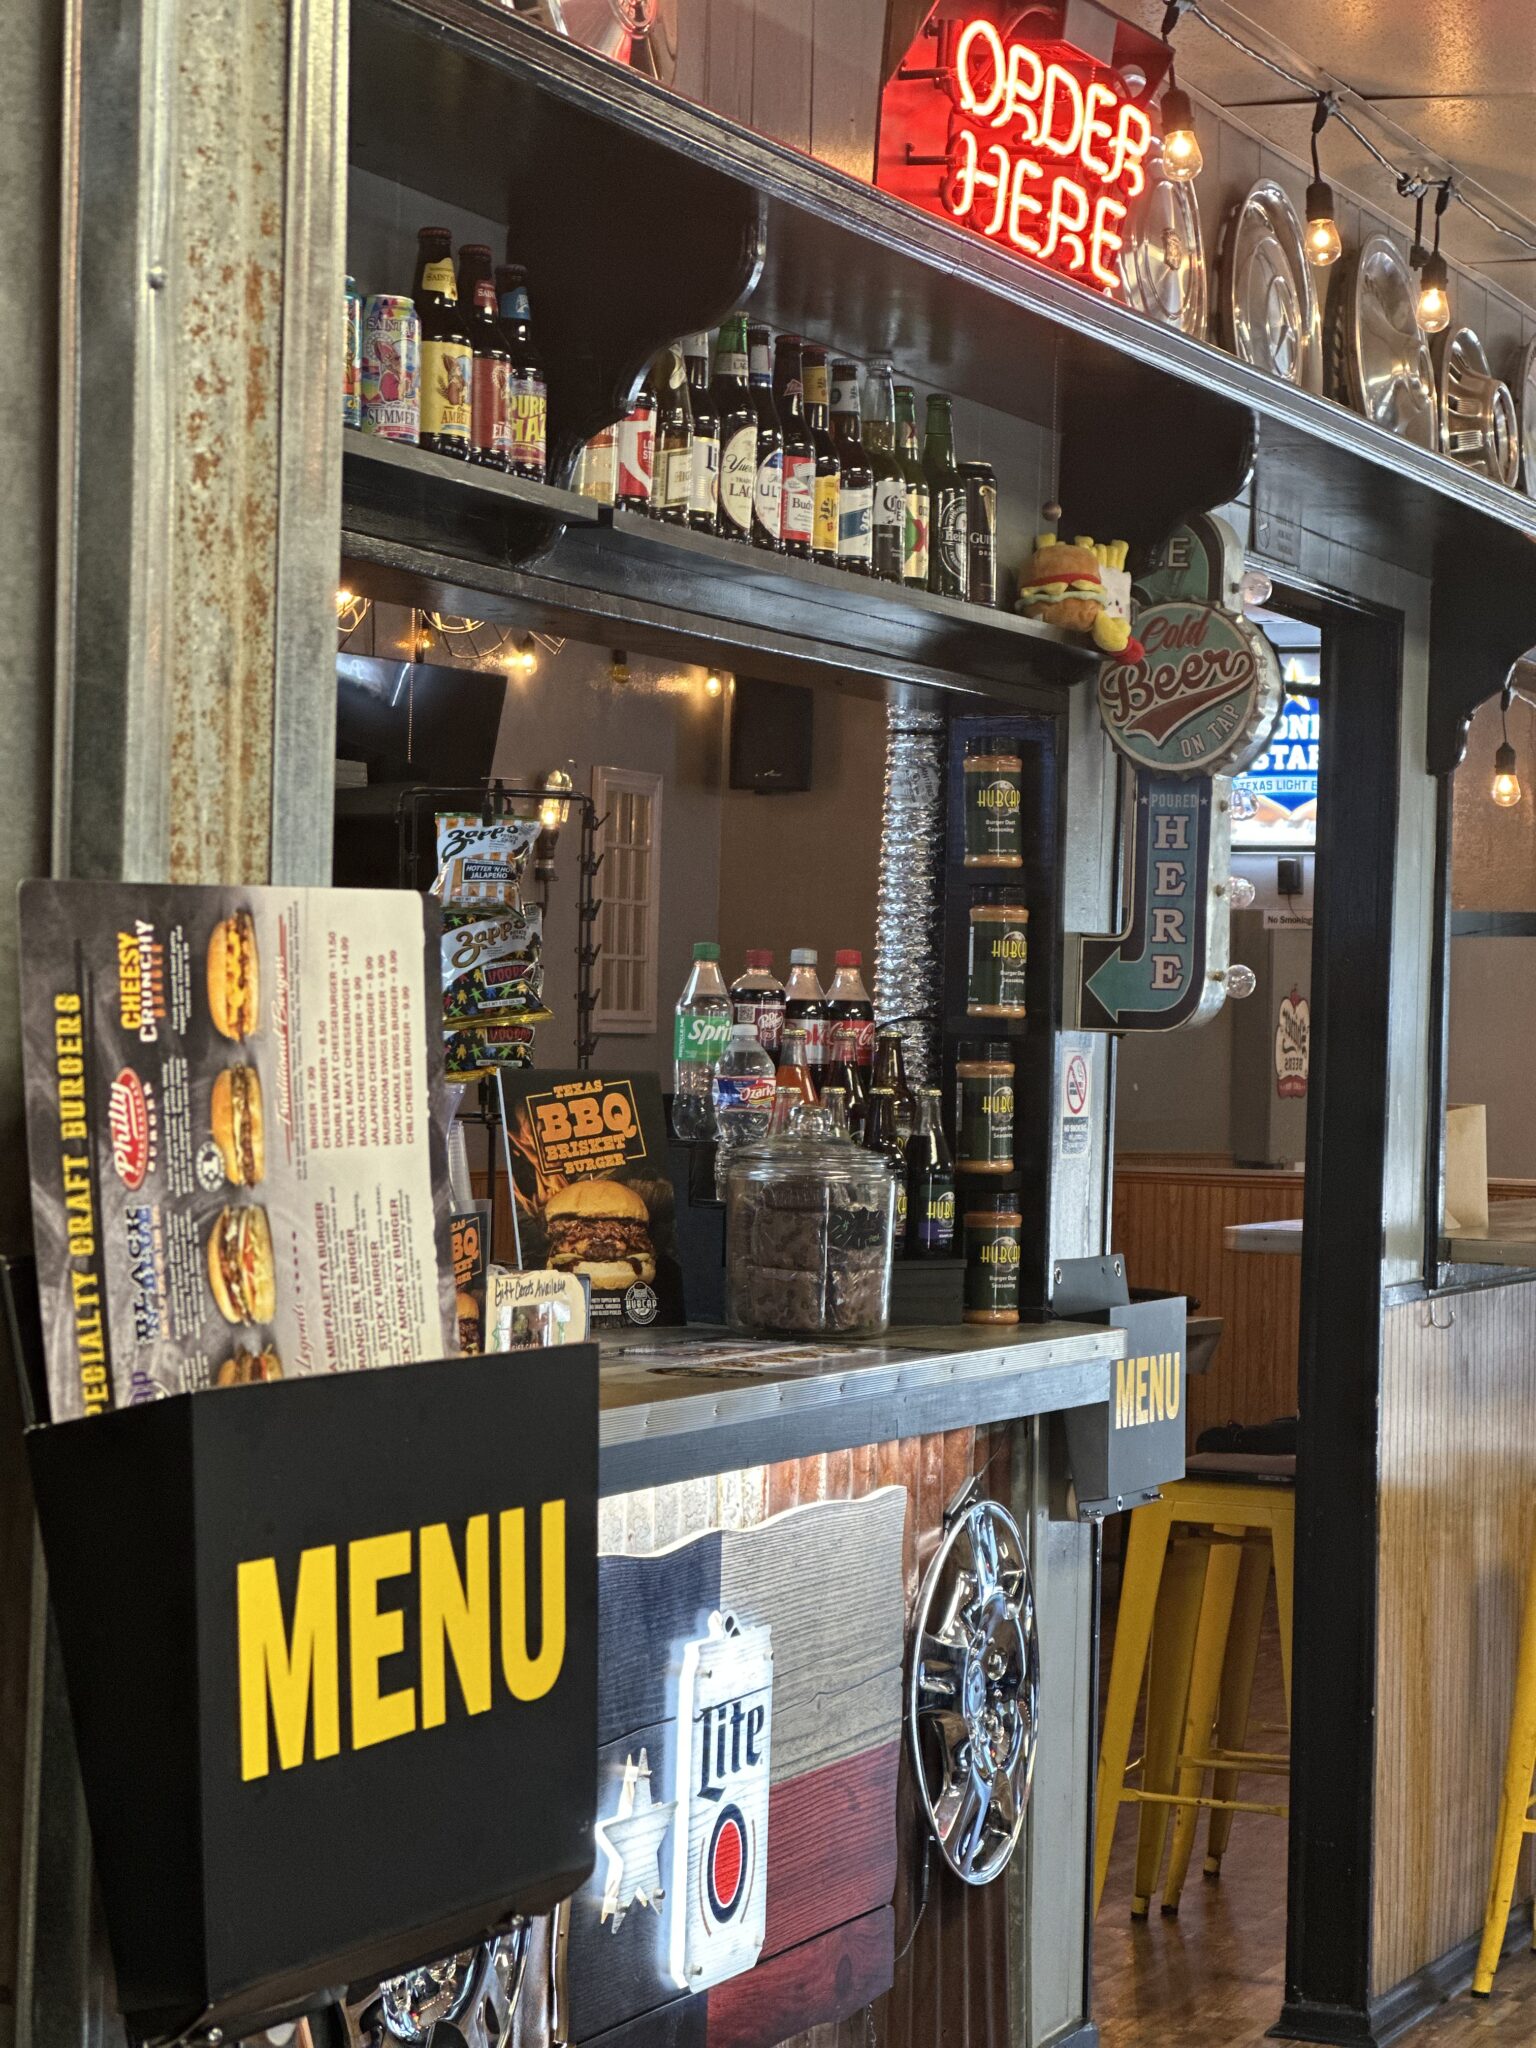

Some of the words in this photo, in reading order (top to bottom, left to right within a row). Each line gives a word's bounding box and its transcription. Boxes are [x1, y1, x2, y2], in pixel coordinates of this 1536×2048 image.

[957, 19, 1152, 197] ORDER
[953, 130, 1128, 288] HERE
[368, 408, 415, 426] SUMMER
[1140, 610, 1213, 655] Cold
[1099, 648, 1256, 728] Beer
[1178, 736, 1206, 759] ON
[1207, 703, 1240, 739] TAP
[1151, 793, 1198, 808] POURED
[1276, 779, 1309, 791] LIGHT
[466, 864, 492, 873] HOTTER
[1150, 814, 1191, 991] HERE
[1267, 915, 1279, 925] No
[118, 932, 141, 1029] CHEESY
[136, 919, 157, 1042] CRUNCHY
[328, 972, 339, 1062] CHEESEBURGER
[341, 979, 352, 1068] CHEESEBURGER
[378, 991, 387, 1035] BURGER
[390, 986, 399, 1030] BURGER
[354, 1013, 365, 1102] CHEESEBURGER
[366, 993, 376, 1082] CHEESEBURGER
[379, 1040, 388, 1075] SWISS
[391, 1034, 400, 1070] SWISS
[402, 1022, 412, 1066] BURGER
[54, 993, 87, 1140] BURGERS
[331, 1067, 340, 1099] MEAT
[344, 1073, 353, 1105] MEAT
[403, 1070, 413, 1113] CHEESE
[552, 1079, 604, 1100] TEXAS
[108, 1082, 138, 1177] Philly
[308, 1104, 318, 1149] BURGER
[318, 1057, 331, 1149] CHEESEBURGER
[333, 1103, 343, 1148] DOUBLE
[345, 1108, 355, 1147] TRIPLE
[357, 1106, 367, 1146] BACON
[380, 1079, 391, 1145] MUSHROOM
[392, 1074, 403, 1145] GUACAMOLE
[405, 1116, 414, 1144] CHILI
[535, 1091, 637, 1144] BBQ
[544, 1133, 627, 1163] BRISKET
[563, 1152, 627, 1175] BURGER
[62, 1154, 95, 1257] CRAFT
[315, 1202, 327, 1258] BURGER
[390, 1198, 402, 1259] BURGER
[125, 1207, 149, 1341] BLACK
[346, 1228, 358, 1284] BURGER
[370, 1240, 383, 1296] BURGER
[319, 1262, 336, 1357] MUFFALETTA
[350, 1289, 362, 1314] BLT
[395, 1264, 407, 1329] MONKEY
[494, 1278, 515, 1308] Gift
[354, 1318, 366, 1369] RANCH
[375, 1301, 388, 1351] STICKY
[1115, 1351, 1181, 1430] MENU
[237, 1498, 566, 1783] MENU
[696, 1700, 765, 1804] Lite
